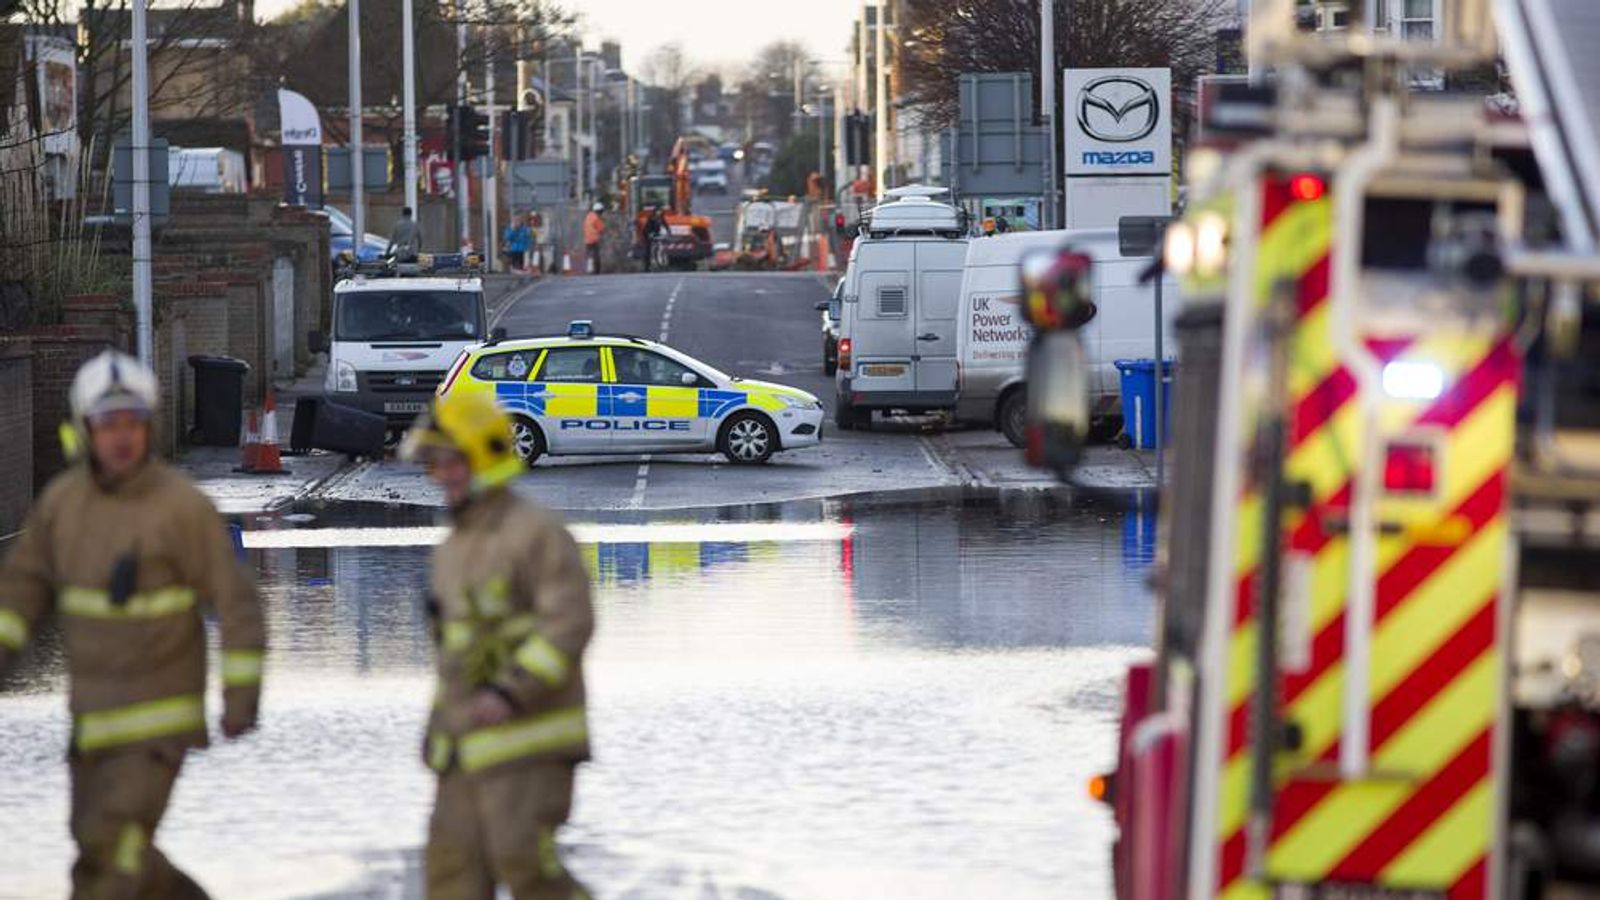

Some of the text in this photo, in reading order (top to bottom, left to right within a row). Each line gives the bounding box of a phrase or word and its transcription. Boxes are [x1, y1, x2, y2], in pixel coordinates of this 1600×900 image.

[1082, 151, 1154, 164] mazda
[972, 297, 990, 311] UK
[972, 313, 1011, 327] Power
[560, 419, 691, 430] POLICE
